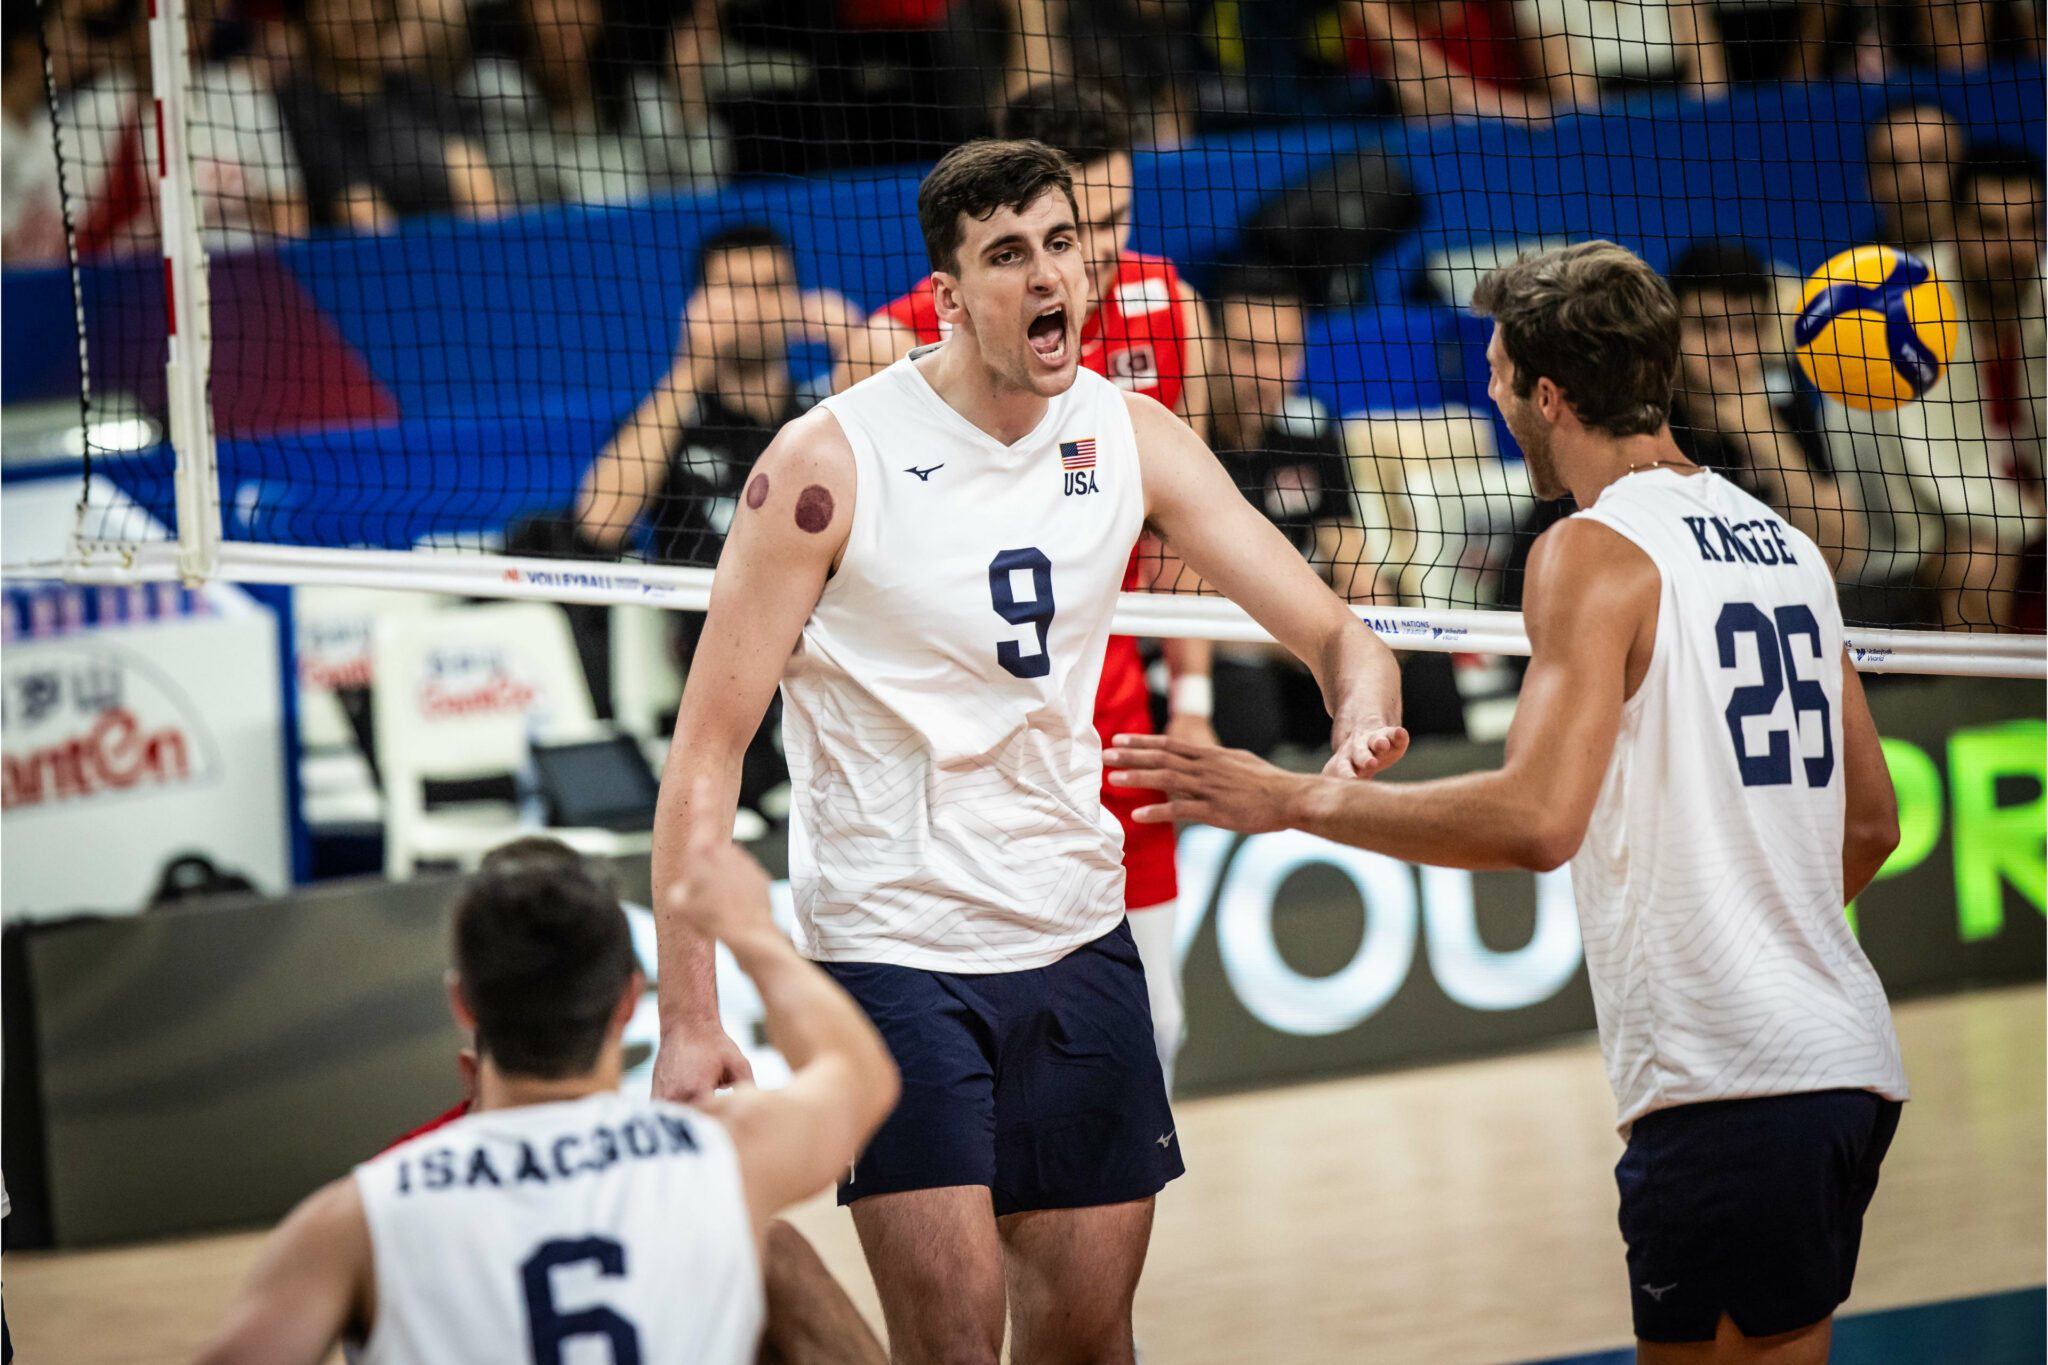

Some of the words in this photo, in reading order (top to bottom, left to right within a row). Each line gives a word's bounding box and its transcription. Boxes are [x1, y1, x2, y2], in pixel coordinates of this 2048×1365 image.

[1064, 470, 1099, 496] USA
[527, 571, 612, 589] VOLLEYBALL
[989, 547, 1055, 678] 9
[1715, 602, 1834, 787] 26
[398, 1113, 701, 1193] ISAACSON
[520, 1235, 642, 1365] 6
